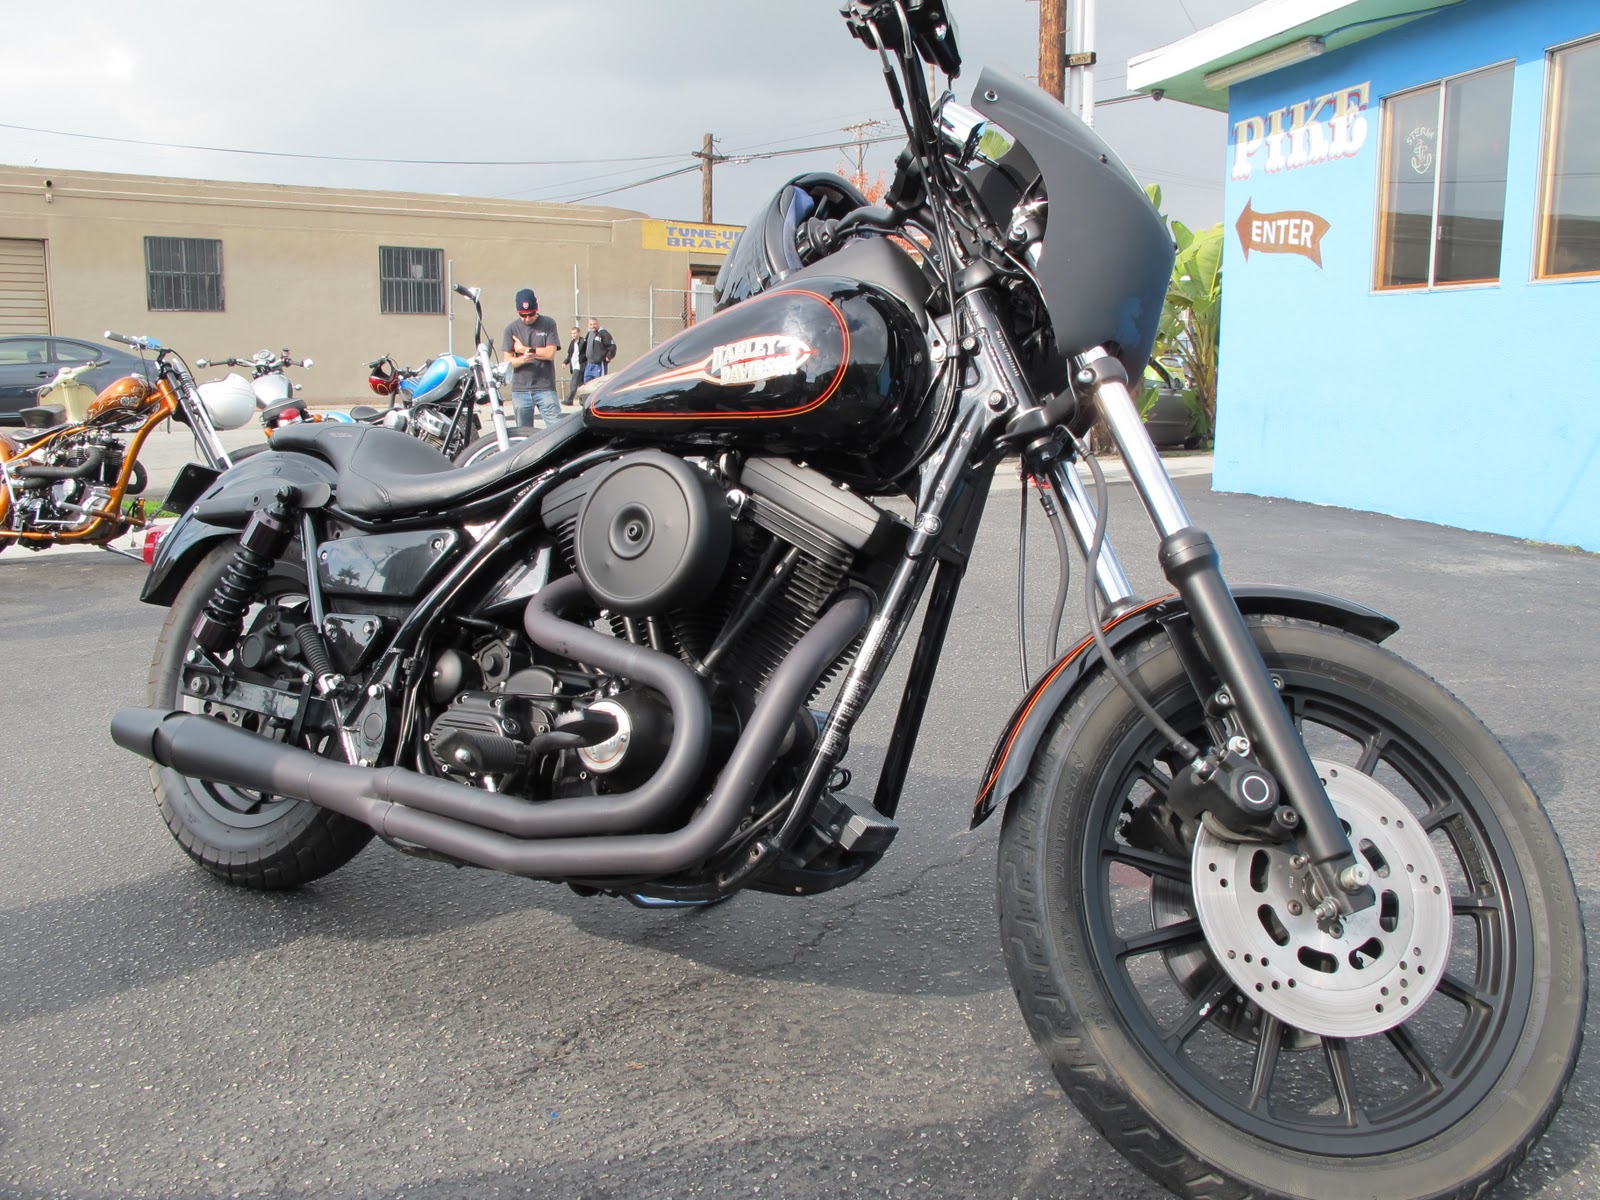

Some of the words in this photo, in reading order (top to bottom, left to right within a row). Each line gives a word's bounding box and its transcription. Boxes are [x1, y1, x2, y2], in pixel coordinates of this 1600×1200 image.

[1231, 80, 1371, 181] PIKE
[667, 237, 734, 250] BRAK
[1251, 218, 1314, 249] ENTER
[711, 335, 781, 374] HARLEY
[720, 355, 797, 386] DAVIDSON
[1053, 750, 1086, 878] DAVIDSON
